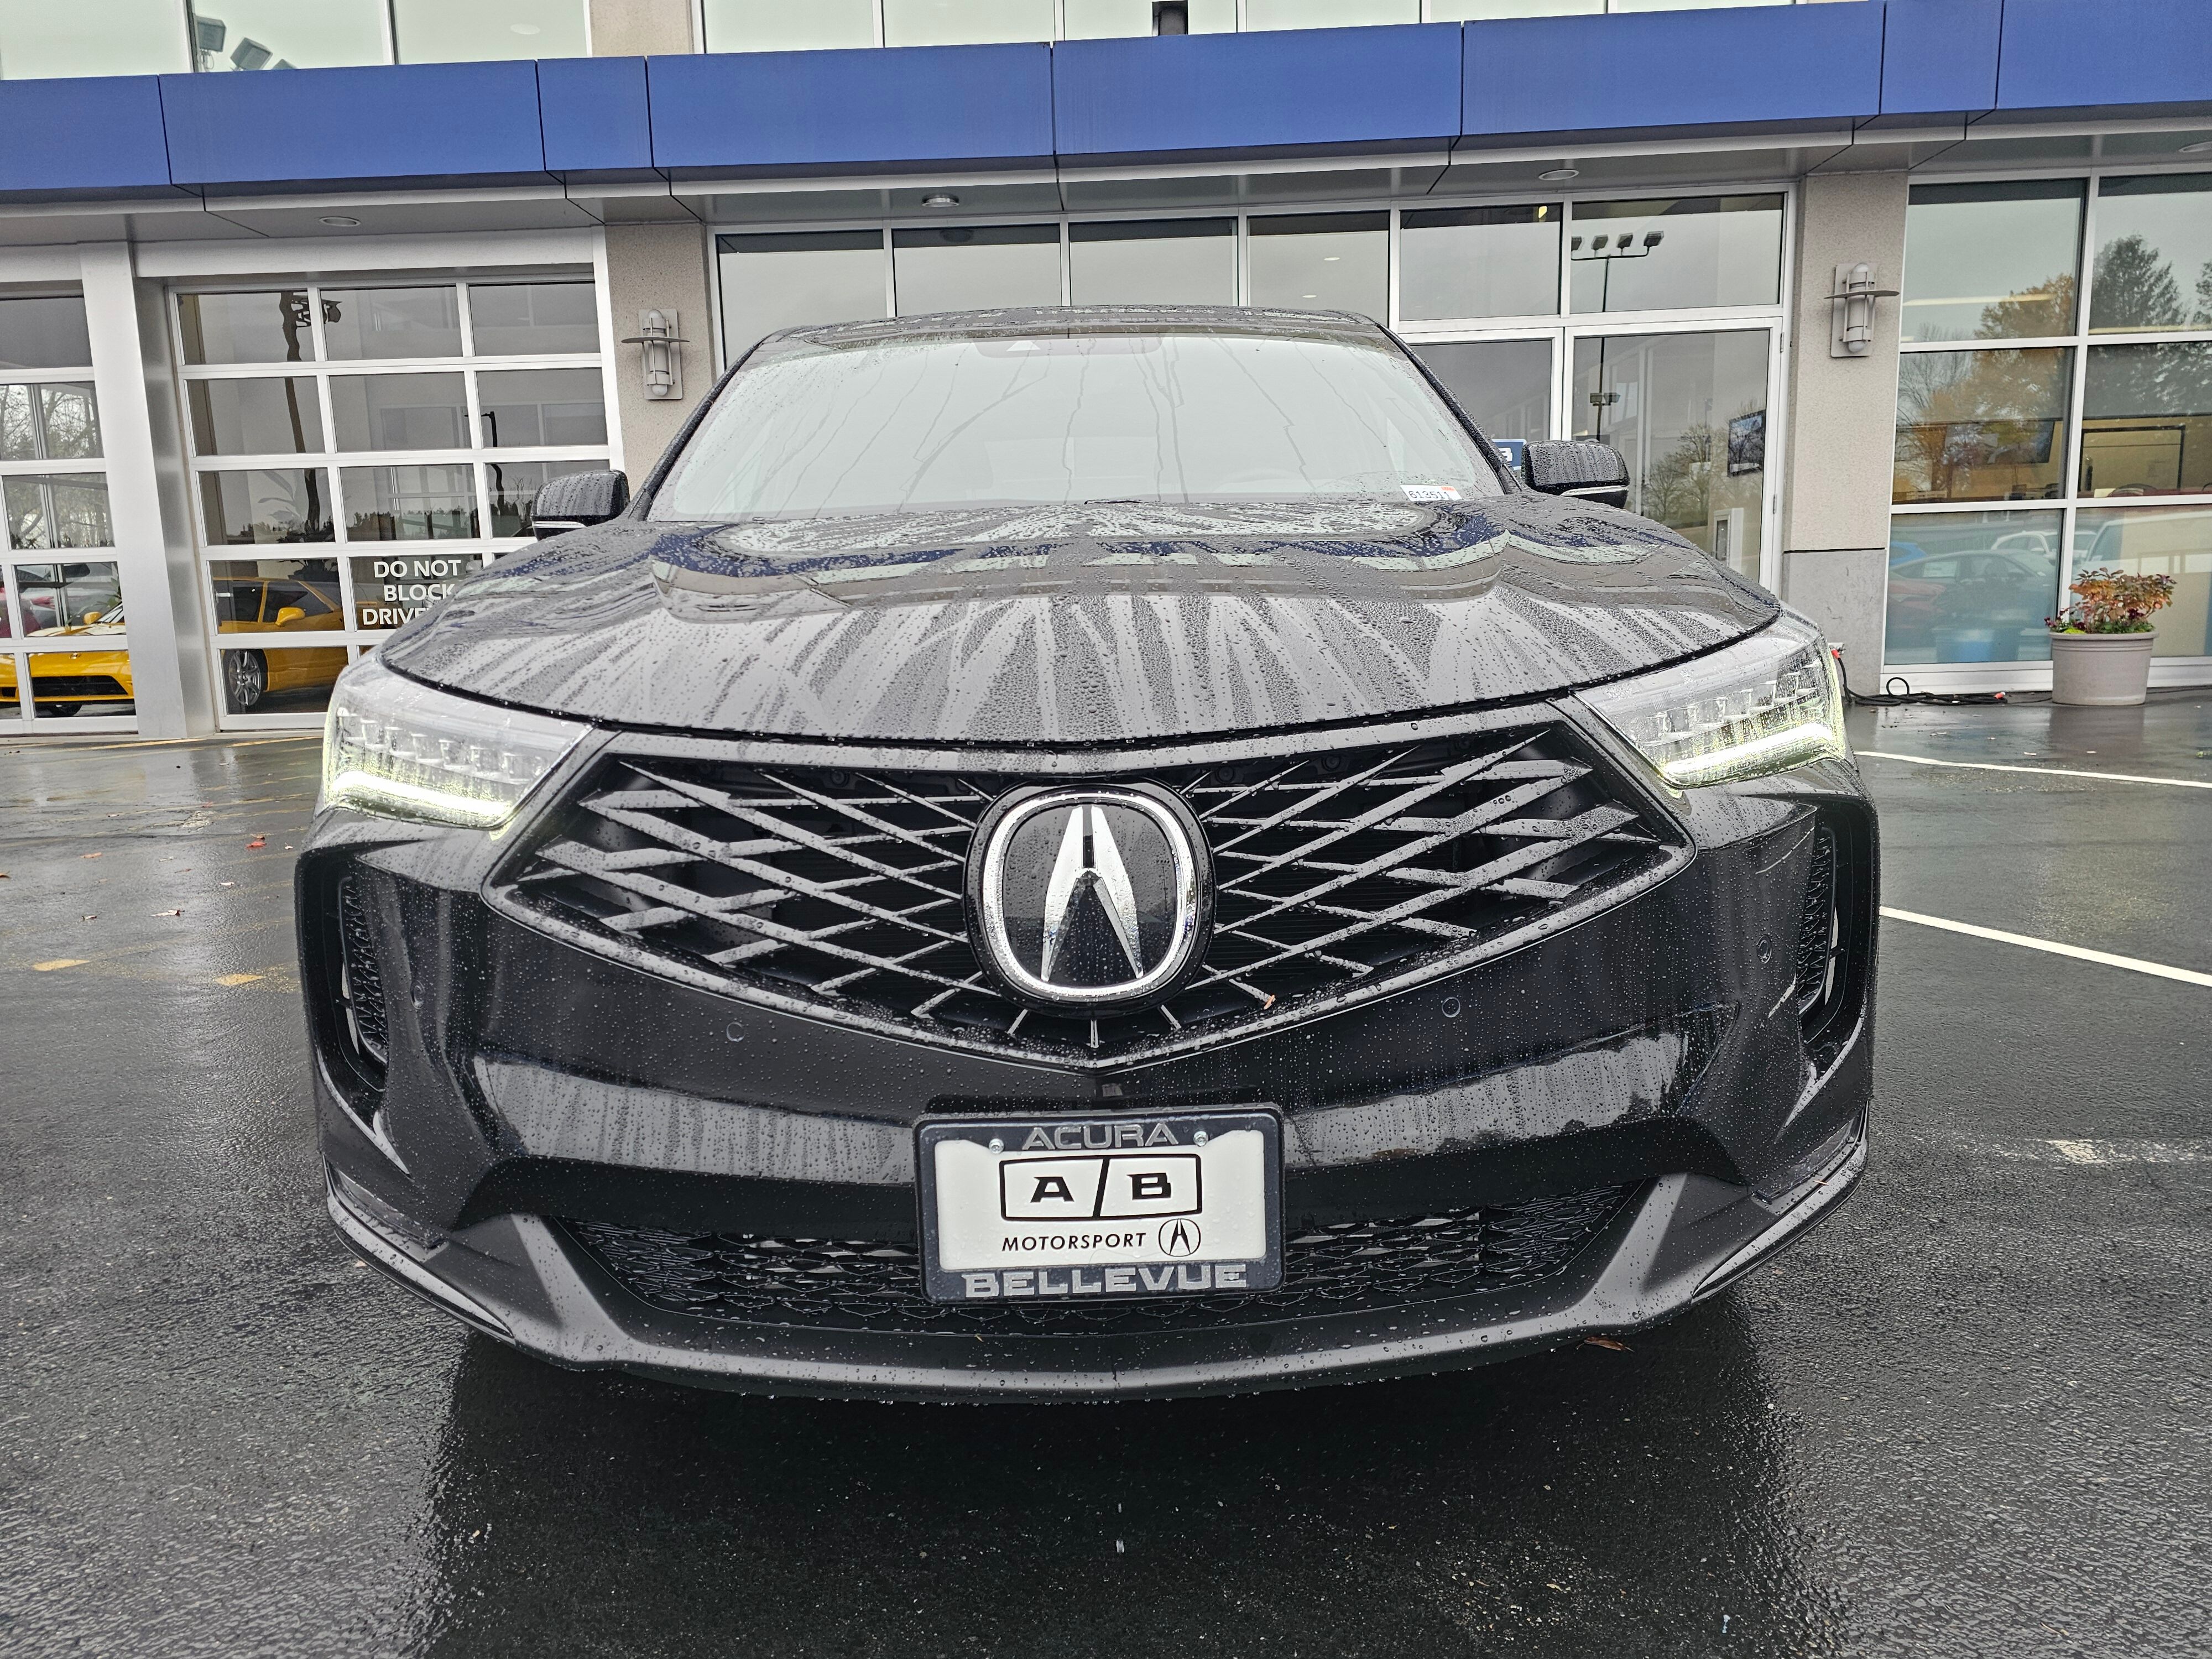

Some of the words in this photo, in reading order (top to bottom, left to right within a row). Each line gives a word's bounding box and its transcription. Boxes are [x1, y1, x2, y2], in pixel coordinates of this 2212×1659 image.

[1408, 491, 1452, 499] 613511
[374, 561, 408, 578] DO
[414, 560, 461, 577] NOT
[383, 583, 455, 602] BLOCK
[1022, 1123, 1179, 1150] ACURA
[1001, 1232, 1147, 1253] MOTORSPORT
[962, 1264, 1247, 1298] BELLEVUE
